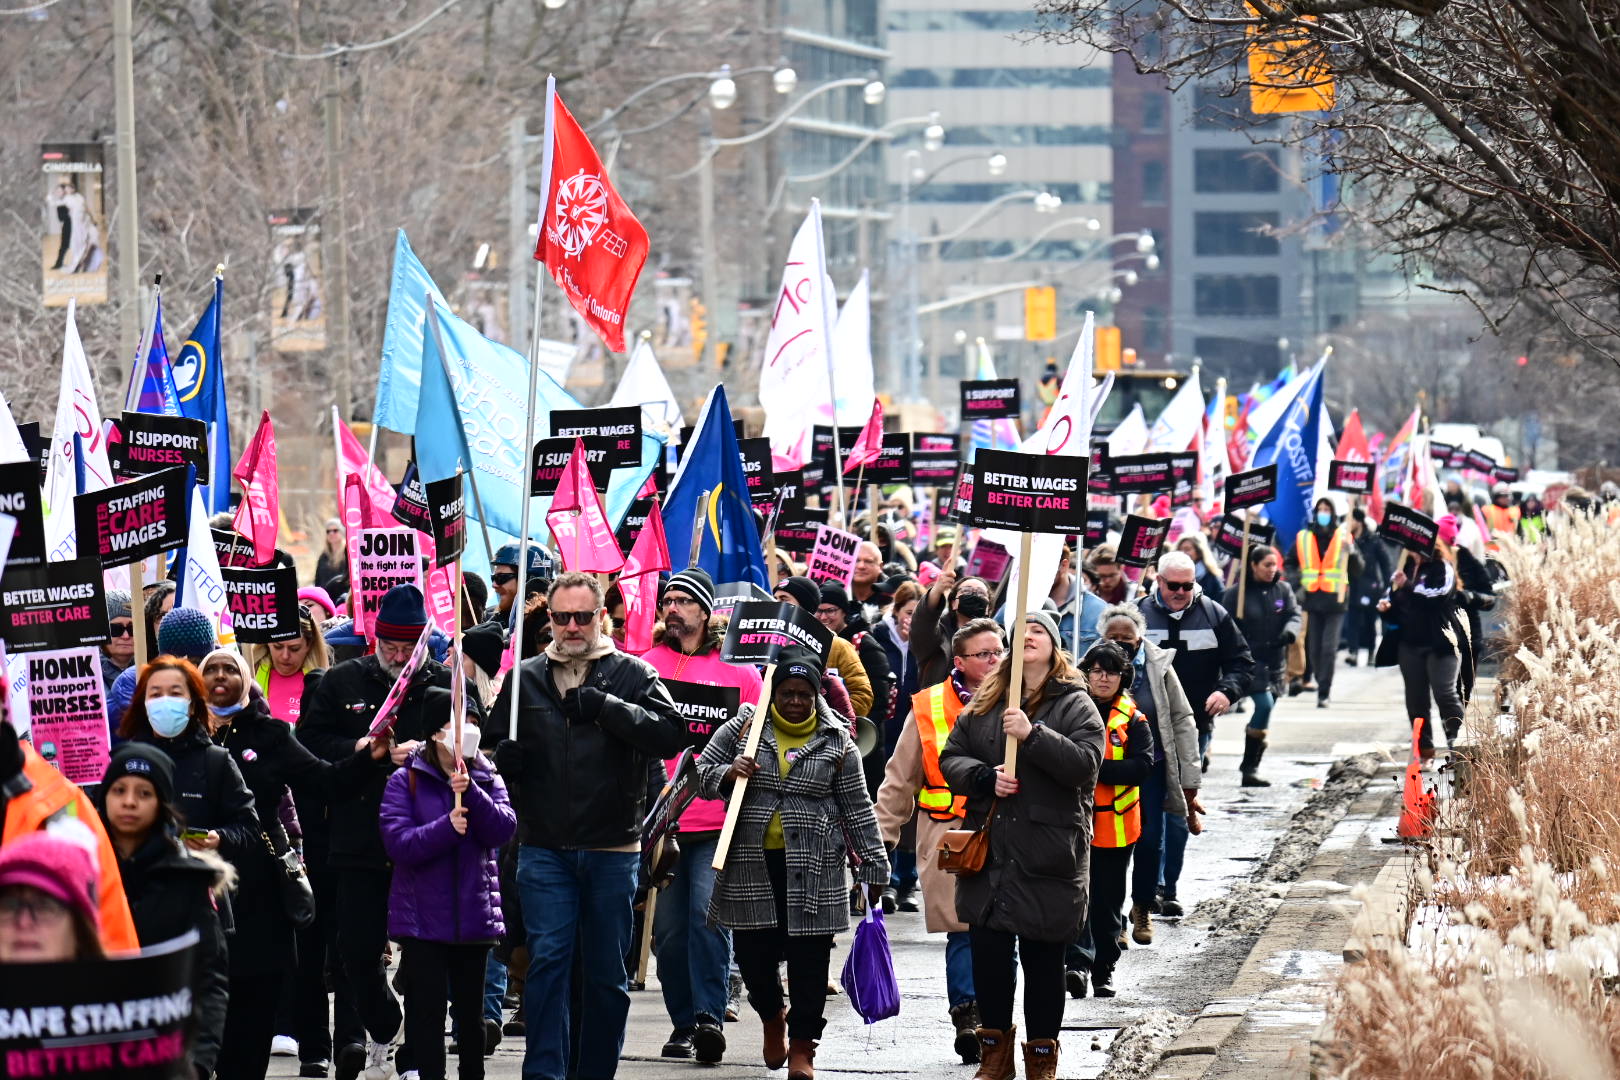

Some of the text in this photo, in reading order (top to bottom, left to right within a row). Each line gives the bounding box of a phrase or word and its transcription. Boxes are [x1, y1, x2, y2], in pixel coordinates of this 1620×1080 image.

[42, 162, 103, 172] CINDERELLA
[596, 229, 628, 258] FEEO
[591, 299, 620, 324] Ontario
[971, 388, 1015, 399] SUPPORT
[129, 430, 199, 450] I SUPPORT
[599, 424, 635, 436] WAGES
[128, 447, 187, 464] NURSES.
[538, 454, 544, 466] I
[984, 472, 1028, 489] BETTER
[1031, 476, 1077, 491] WAGES
[108, 485, 165, 515] STAFFING
[988, 491, 1070, 510] BETTER CARE
[109, 499, 167, 535] CARE
[1389, 514, 1434, 539] SAFE STAFFING
[97, 502, 112, 555] BETTER
[109, 519, 167, 552] WAGES
[360, 533, 415, 556] JOIN
[819, 529, 858, 557] JOIN
[361, 560, 415, 572] the fight for
[812, 559, 849, 581] DECENT
[3, 583, 95, 606] BETTER WAGES
[225, 581, 276, 595] TAFFING
[230, 594, 278, 614] ARE
[11, 605, 92, 626] BETTER CARE
[738, 618, 823, 654] BETTER WAGES
[740, 633, 788, 647] BETTER
[29, 655, 95, 681] HONK
[31, 680, 97, 695] to support
[30, 694, 102, 716] NURSES
[38, 715, 65, 725] HEALTH
[66, 712, 104, 722] WORKERS
[0, 987, 192, 1039] SAFE STAFFING
[6, 1030, 184, 1078] BETTER CARE
